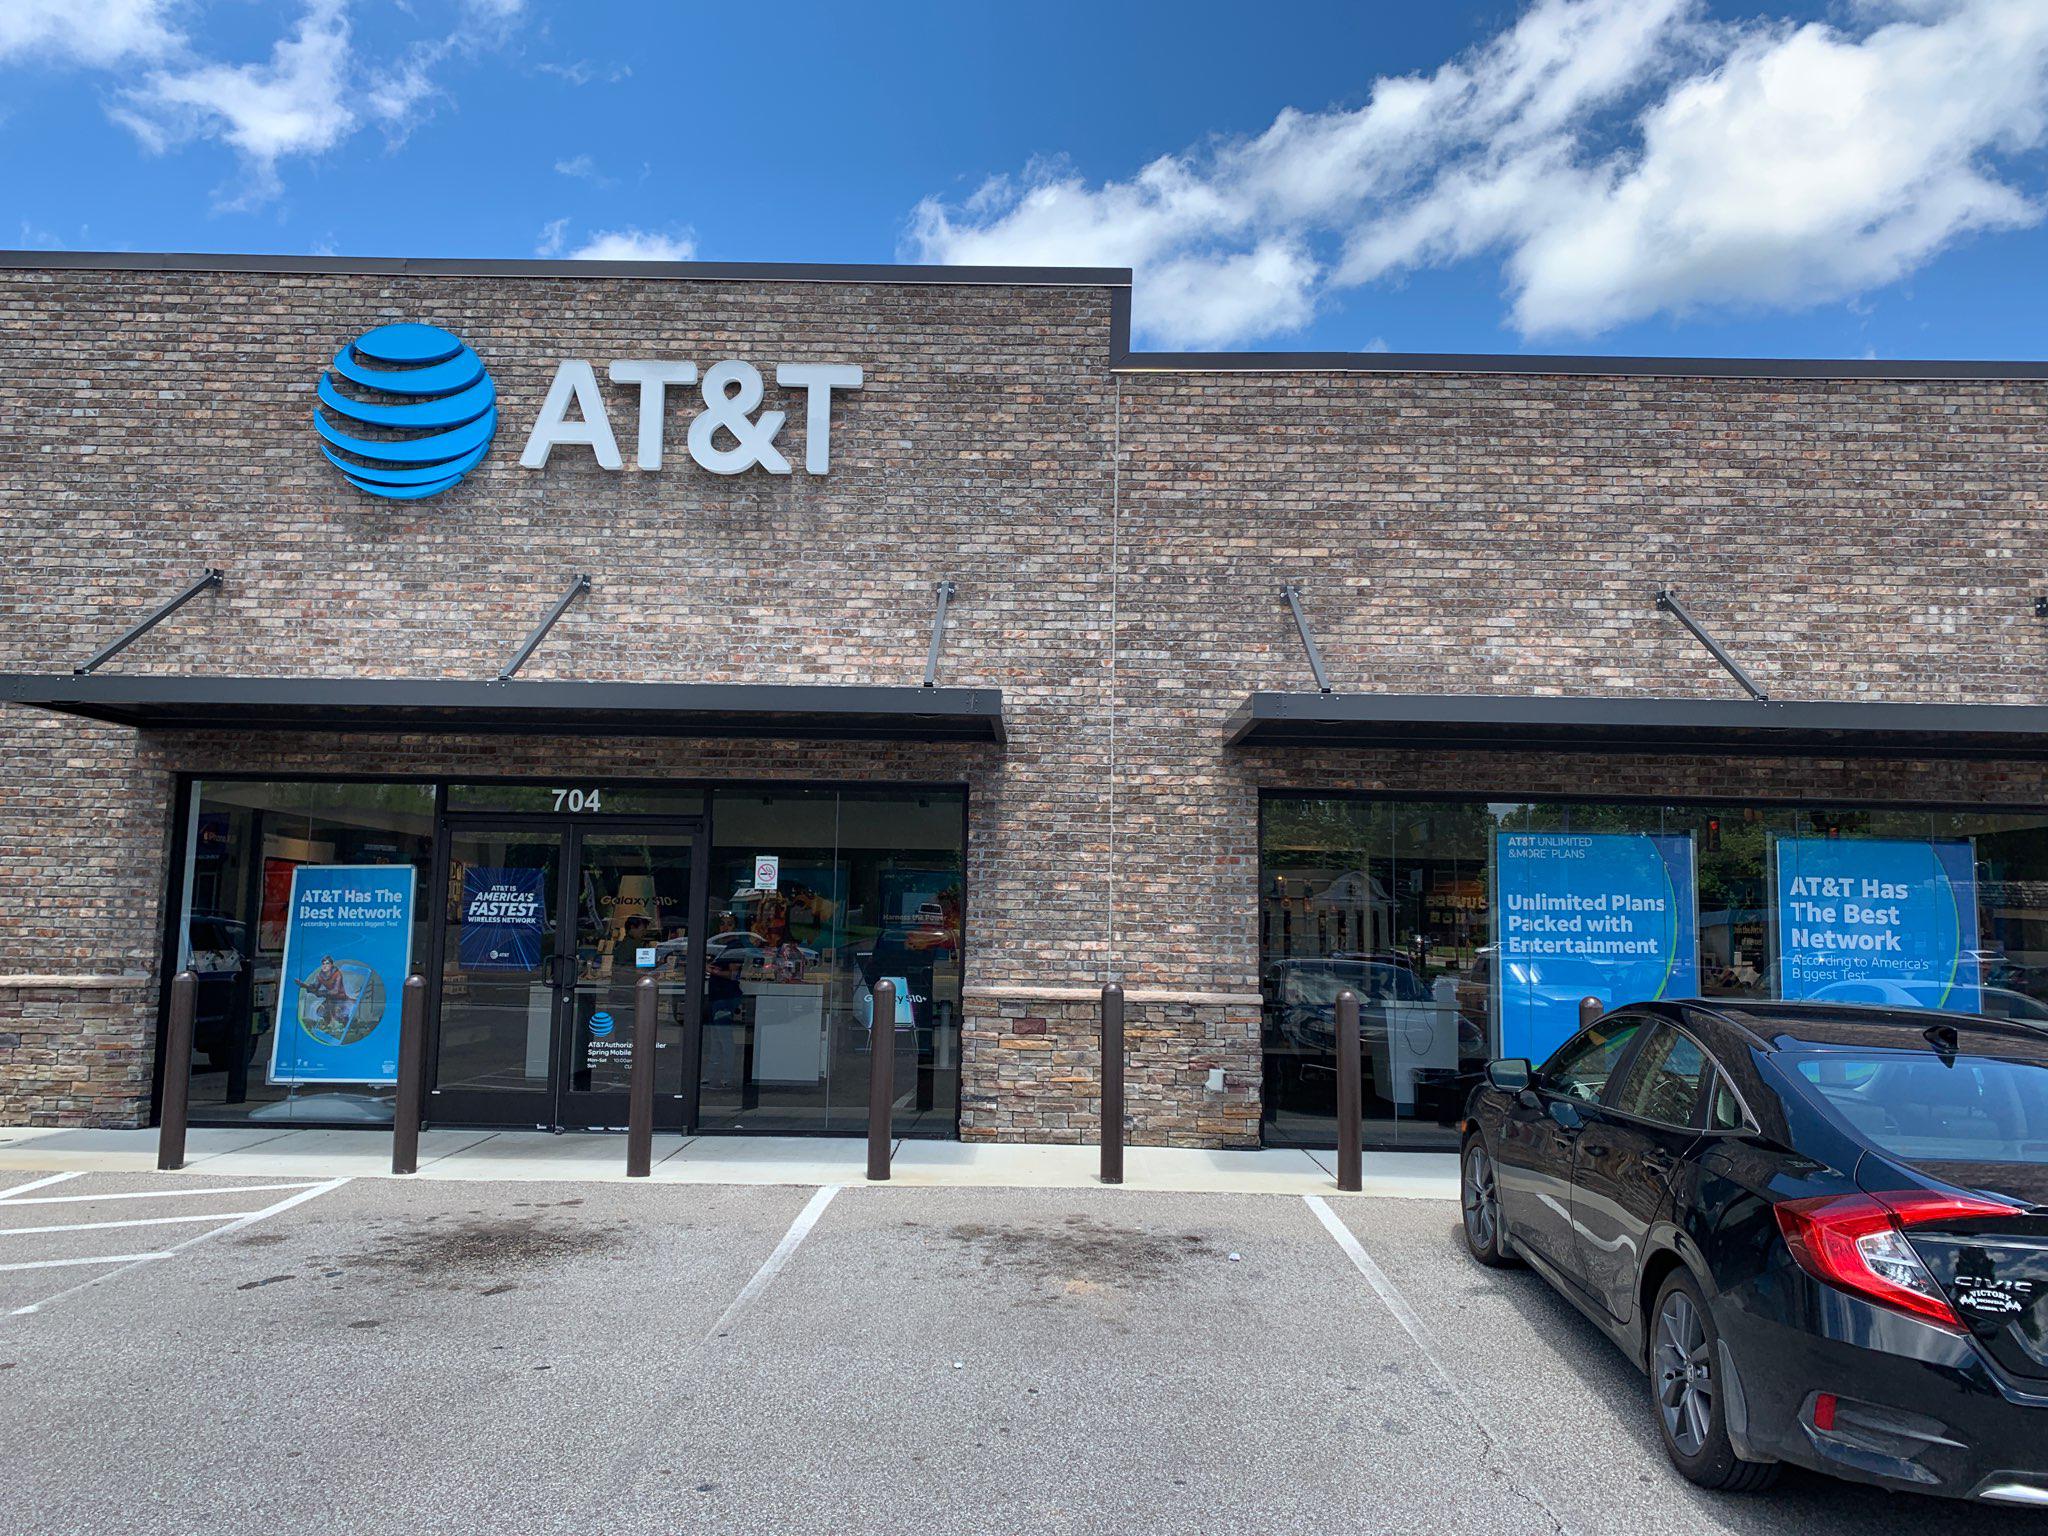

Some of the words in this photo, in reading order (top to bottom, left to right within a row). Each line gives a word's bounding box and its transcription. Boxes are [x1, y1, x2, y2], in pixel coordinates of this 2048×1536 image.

[519, 359, 863, 475] AT&T
[551, 788, 602, 812] 704
[1507, 837, 1536, 846] AT&T
[1537, 837, 1593, 847] UNLIMITED
[1551, 849, 1586, 859] PLANS
[300, 889, 342, 903] AT&T
[344, 889, 372, 903] Has
[374, 888, 403, 903] The
[1789, 876, 1855, 898] AT&T
[1861, 878, 1909, 900] Has
[474, 892, 535, 902] AMERICA'S
[600, 895, 649, 906] Galaxy
[1507, 893, 1607, 911] Unlimited
[1611, 894, 1665, 912] Plans
[299, 906, 335, 919] Best
[337, 905, 402, 919] Network
[468, 902, 539, 917] FASTEST
[1789, 901, 1837, 923] The
[1843, 903, 1901, 926] Best
[1508, 914, 1582, 932] Packed
[1586, 915, 1633, 933] with
[1509, 936, 1659, 954] Entertainment
[1791, 928, 1902, 951] Network
[1791, 954, 1851, 970] According
[1853, 956, 1868, 967] to
[1871, 957, 1929, 970] America's
[1792, 969, 1838, 982] Bggest
[604, 1041, 634, 1049] Authoriz
[1954, 1276, 2033, 1293] CIVIC
[1970, 1290, 2012, 1301] VICTORY
